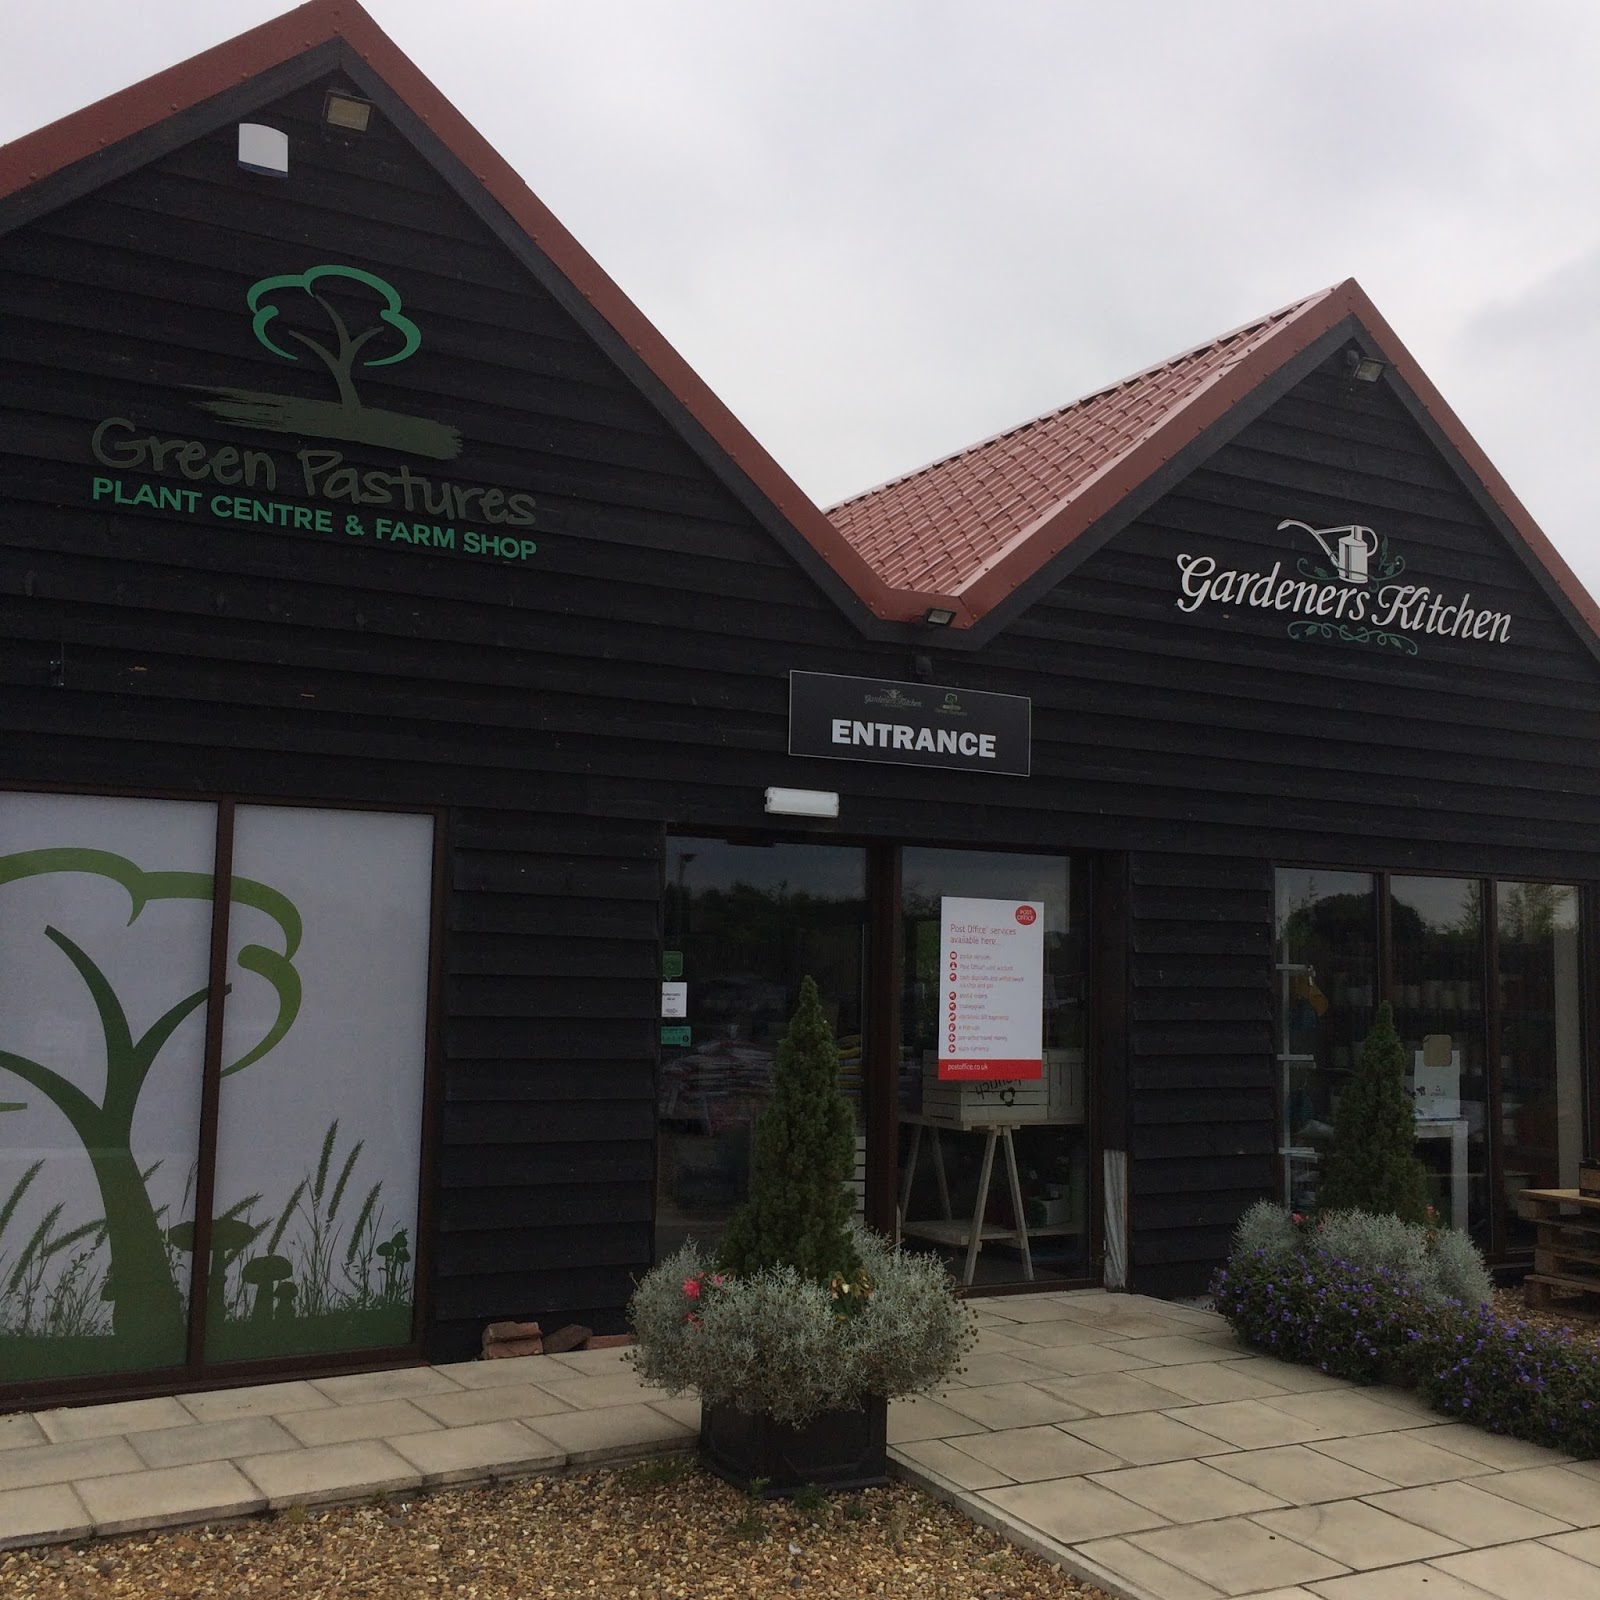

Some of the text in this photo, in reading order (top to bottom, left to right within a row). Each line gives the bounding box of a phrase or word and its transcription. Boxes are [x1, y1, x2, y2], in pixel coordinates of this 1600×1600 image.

[91, 417, 537, 526] Green Pastures
[92, 476, 537, 561] PLANT CENTRE & FARM SHOP
[1176, 553, 1512, 644] Gardeners Kitchen
[831, 718, 996, 758] ENTRANCE
[949, 935, 979, 944] available
[950, 924, 965, 933] Post
[947, 1063, 988, 1071] postoffice.co.uk
